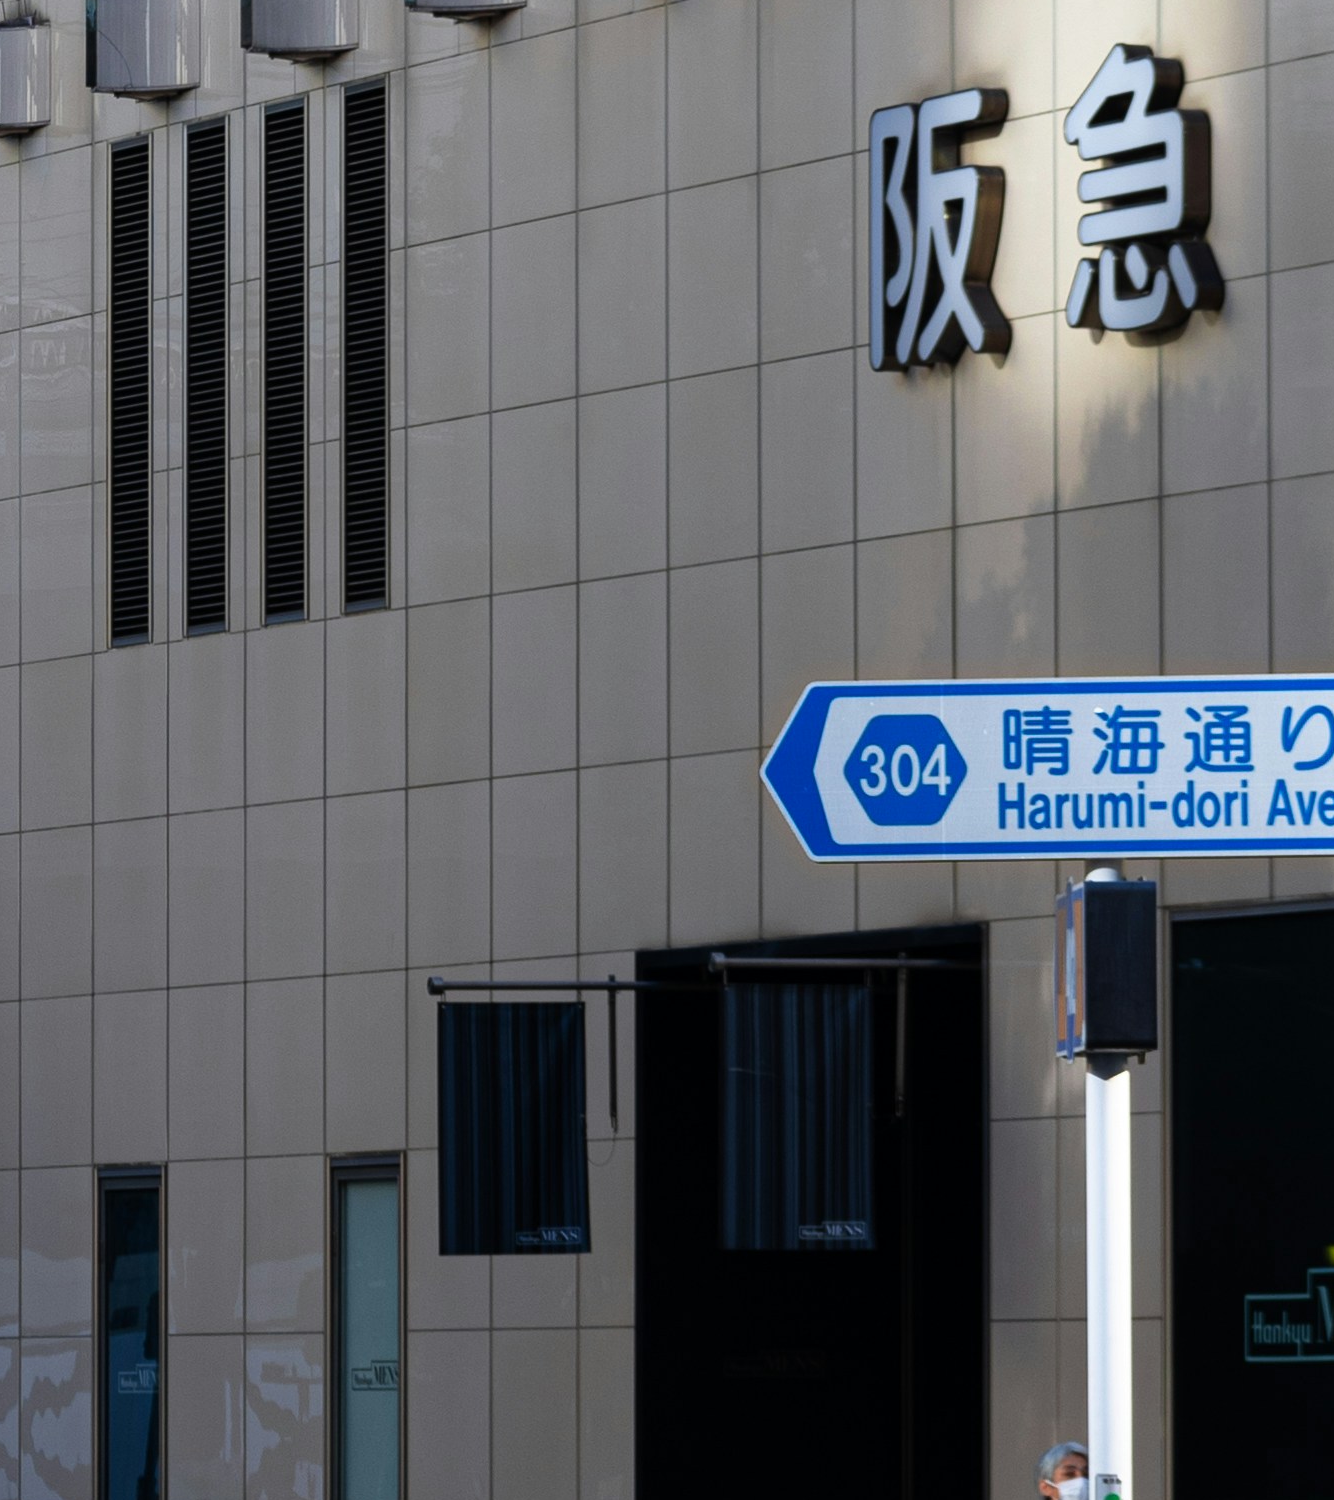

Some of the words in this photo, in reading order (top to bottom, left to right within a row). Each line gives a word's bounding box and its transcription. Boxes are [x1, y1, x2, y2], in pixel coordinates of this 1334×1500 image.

[870, 43, 1225, 372] 阪急
[859, 743, 952, 798] 304
[997, 779, 1248, 831] Harumi-dori
[1252, 1311, 1312, 1357] Hankyu
